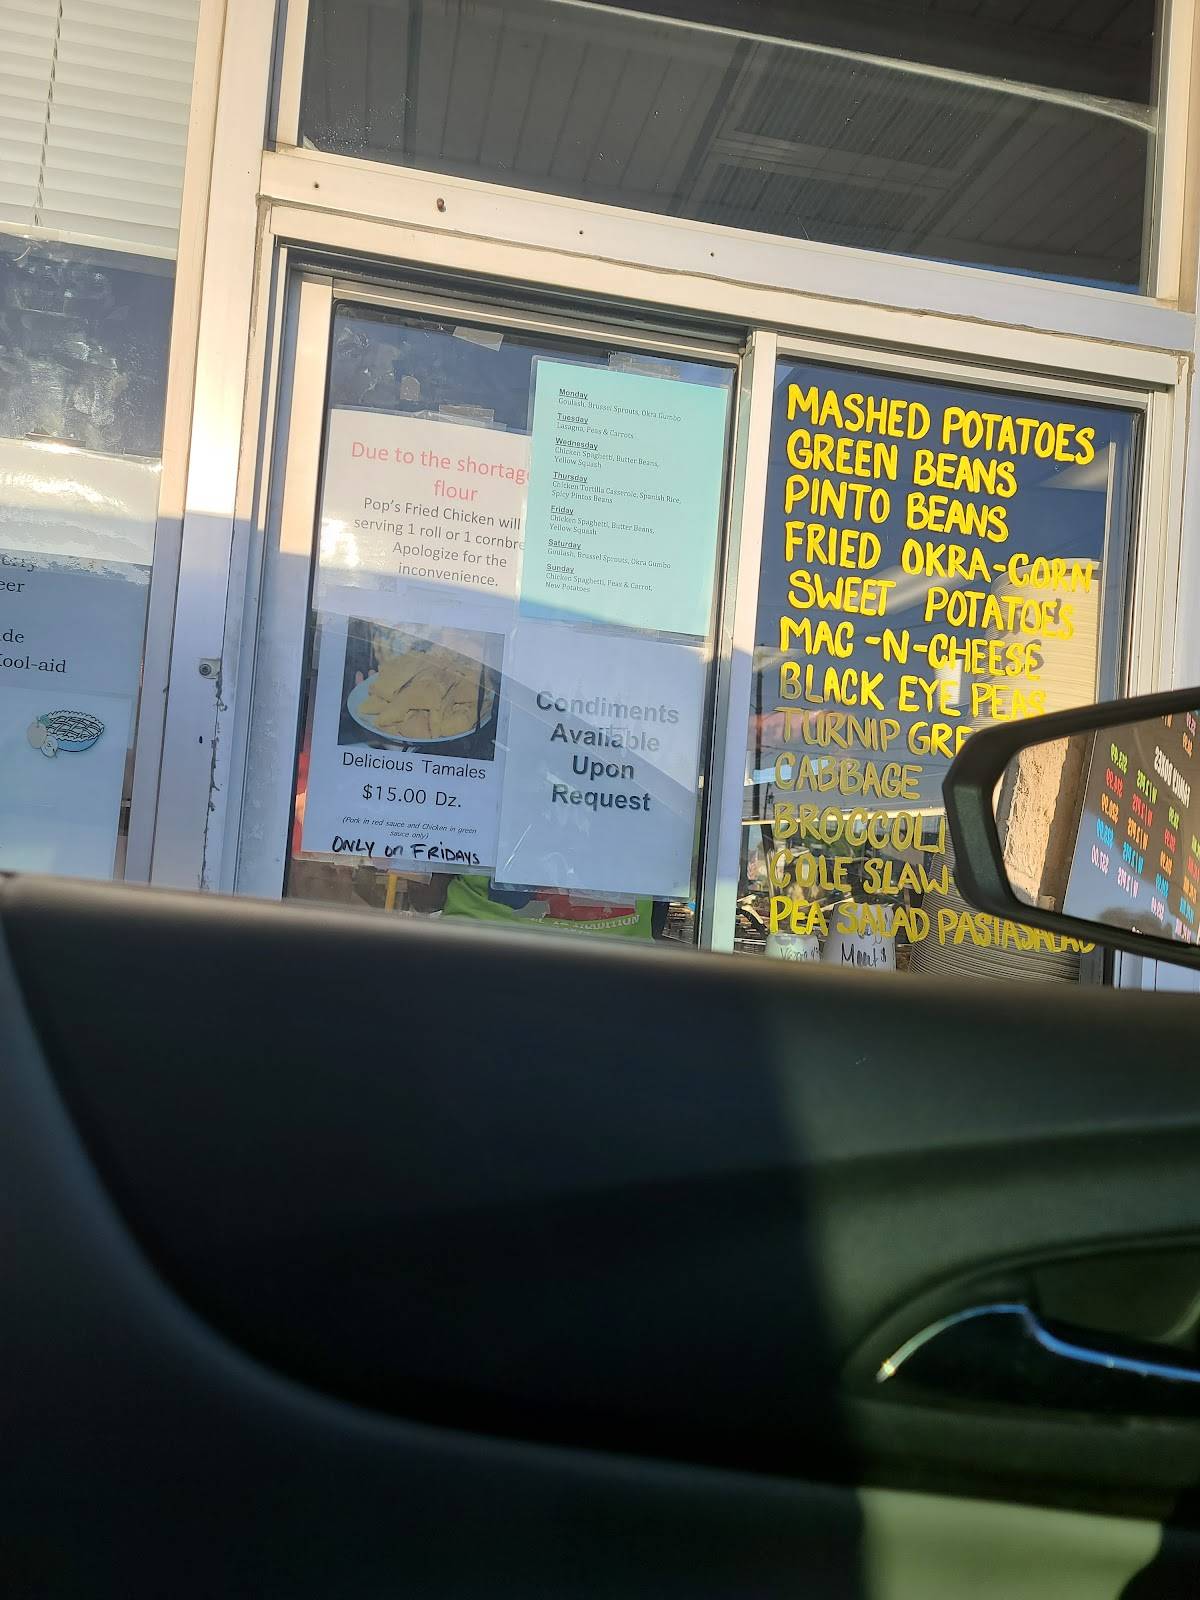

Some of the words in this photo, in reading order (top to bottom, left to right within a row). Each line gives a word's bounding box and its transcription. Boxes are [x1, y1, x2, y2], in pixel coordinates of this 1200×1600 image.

[559, 388, 588, 399] Monday
[557, 413, 589, 424] Tuesday
[787, 383, 931, 440] MASHED
[942, 407, 1097, 466] POTATOES
[555, 447, 581, 457] Chicken
[616, 455, 637, 464] Butter
[556, 437, 598, 451] Wednesday
[352, 442, 389, 460] Due
[395, 448, 414, 464] to
[420, 451, 451, 469] the
[457, 457, 530, 485] shortag
[554, 456, 576, 465] Yellow
[578, 460, 601, 469] Squash
[786, 429, 898, 481] GREEN
[914, 449, 1017, 498] BEANS
[553, 472, 588, 483] Thursday
[434, 480, 478, 501] flour
[552, 481, 579, 490] Chicken
[580, 484, 604, 494] Tortilla
[640, 492, 665, 502] Spanish
[552, 490, 570, 499] Spicy
[593, 495, 612, 503] Beans
[405, 502, 439, 518] Fried
[443, 508, 494, 527] Chicken
[499, 517, 521, 530] will
[551, 505, 573, 515] Friday
[785, 474, 890, 524] PINTO
[907, 492, 1009, 543] BEANS
[354, 518, 403, 535] serving
[408, 523, 415, 535] 1
[420, 526, 442, 539] roll
[446, 530, 460, 540] or
[464, 532, 470, 543] 1
[550, 514, 576, 524] Chicken
[611, 522, 632, 530] Butter
[550, 523, 571, 532] Yellow
[573, 526, 597, 536] Squash
[392, 541, 459, 561] Apologize
[463, 551, 482, 564] for
[485, 554, 507, 567] the
[548, 539, 581, 550] Saturday
[785, 521, 881, 570] FRIED
[399, 562, 498, 587] inconvenience.
[546, 564, 575, 574] Sunday
[546, 573, 572, 582] Chicken
[545, 581, 560, 590] New
[562, 583, 590, 592] Potatoes
[788, 570, 896, 616] SWEET
[924, 586, 1076, 641] POTATOES
[0, 628, 25, 643] de
[779, 616, 854, 658] MAC
[0, 654, 67, 674] ool-aid
[779, 661, 885, 711] BLACK
[898, 675, 962, 716] EYE
[972, 682, 1047, 720] PEAS
[536, 691, 679, 724] Condiments
[550, 723, 660, 752] Available
[774, 706, 900, 752] TURNIP
[342, 752, 413, 772] Delicious
[422, 760, 486, 779] Tamales
[572, 755, 634, 780] Upon
[775, 752, 923, 799] CABBAGE
[362, 784, 426, 804] $15.00
[436, 792, 461, 807] Dz.
[552, 783, 650, 811] Request
[342, 816, 360, 825] (Pork
[422, 823, 447, 832] Chicken
[458, 827, 476, 835] green
[332, 836, 375, 858] ONLY
[770, 848, 853, 893] COLE
[863, 857, 950, 896] SLAW
[769, 896, 829, 936] PEA
[837, 902, 930, 943] SALAD
